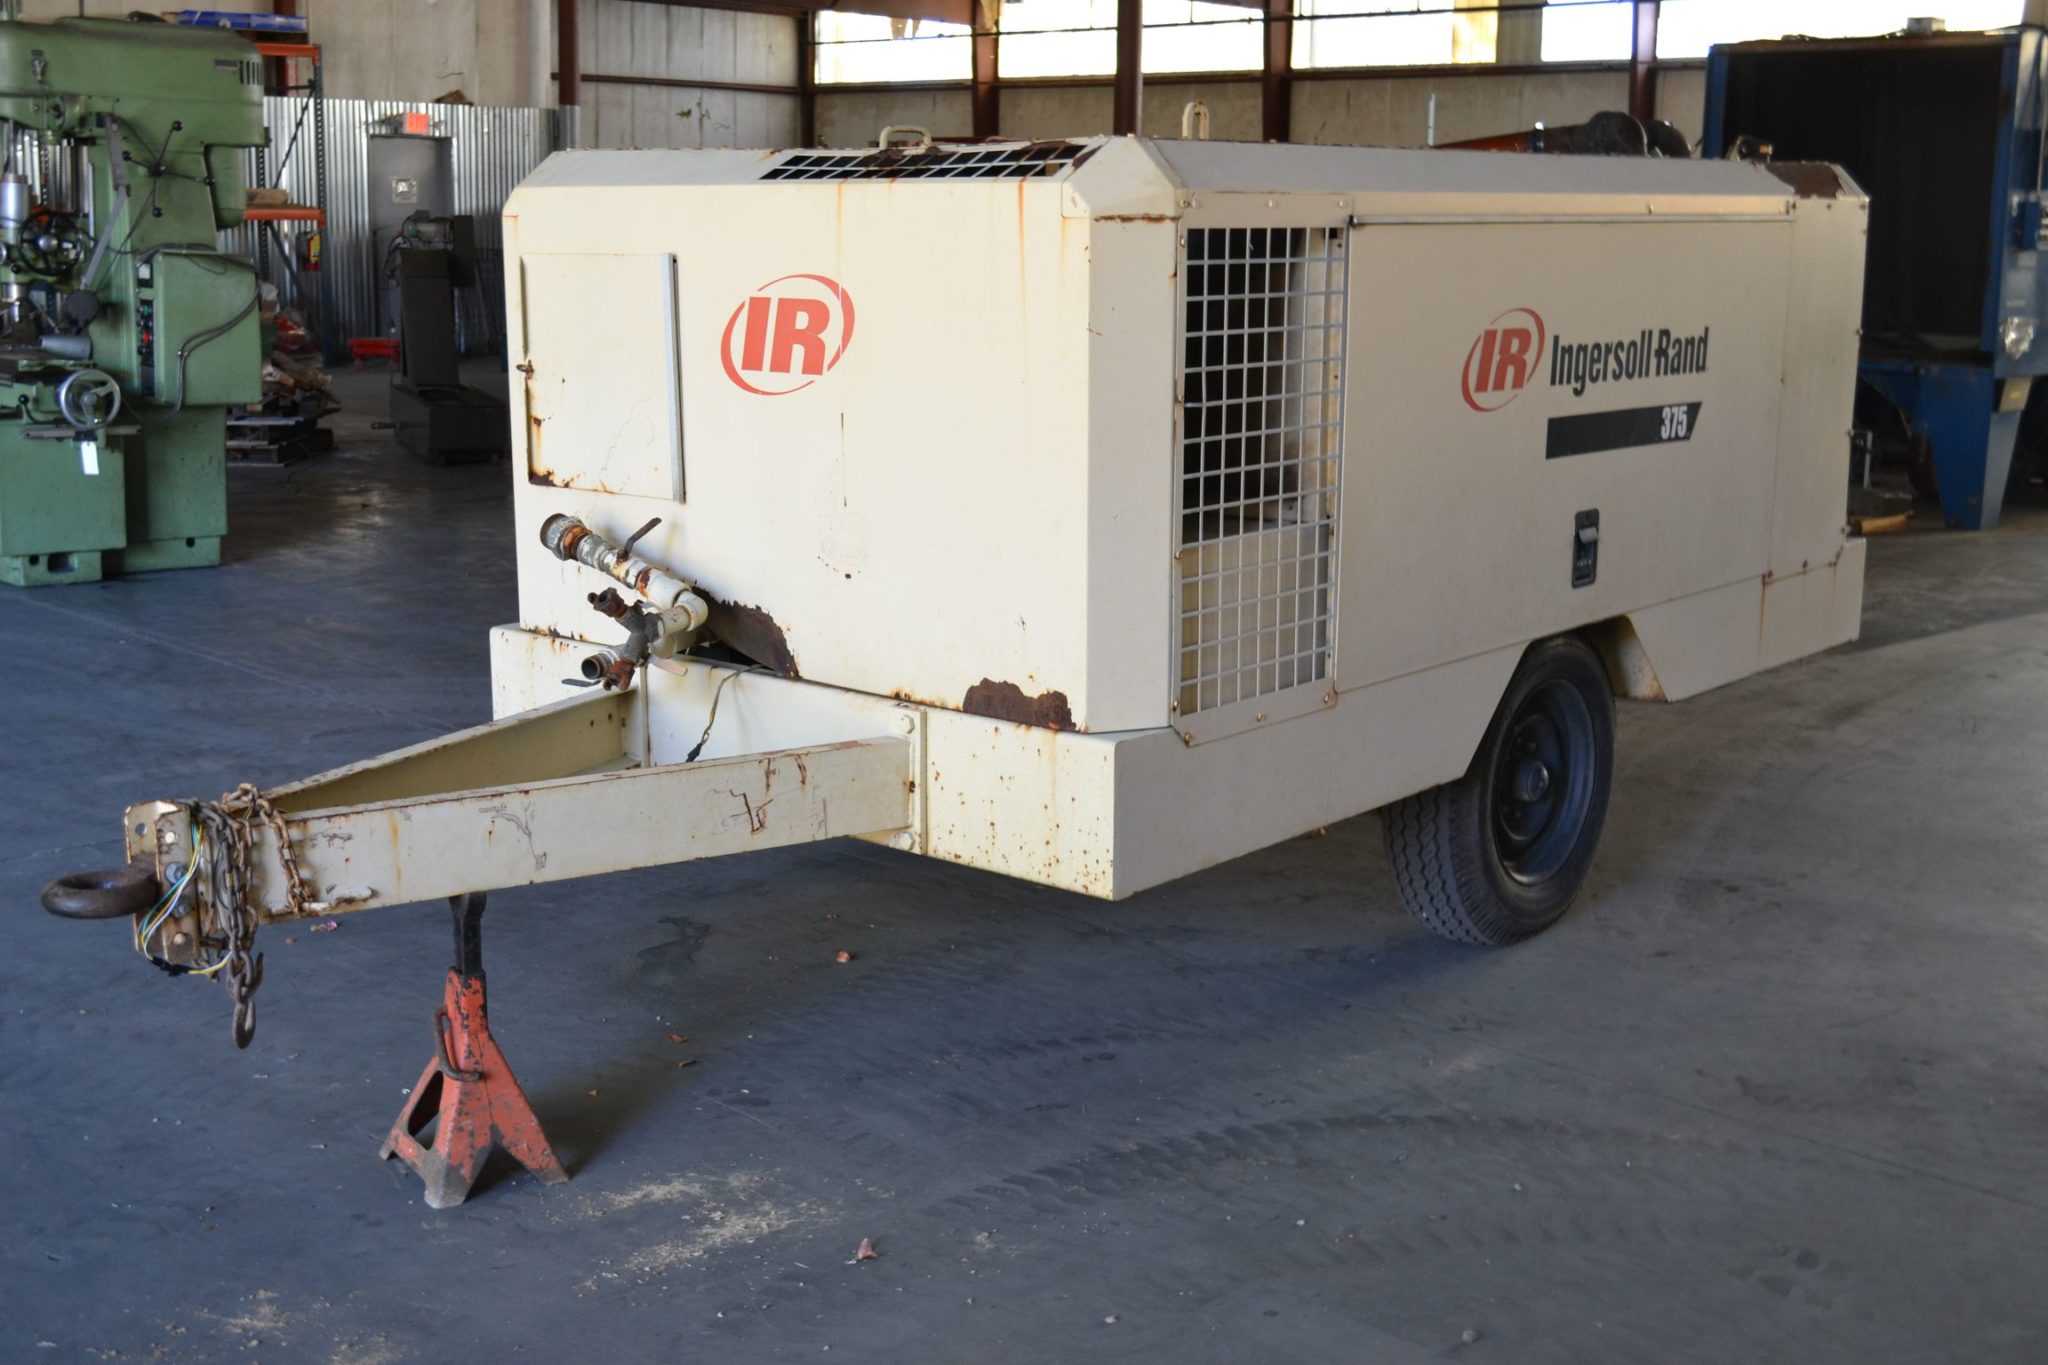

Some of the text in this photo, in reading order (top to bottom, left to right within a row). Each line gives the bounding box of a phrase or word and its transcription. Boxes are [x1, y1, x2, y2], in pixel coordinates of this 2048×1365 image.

[741, 296, 830, 376] IR
[1474, 328, 1532, 393] IR
[1550, 330, 1653, 397] Ingersoll
[1661, 405, 1688, 440] 375
